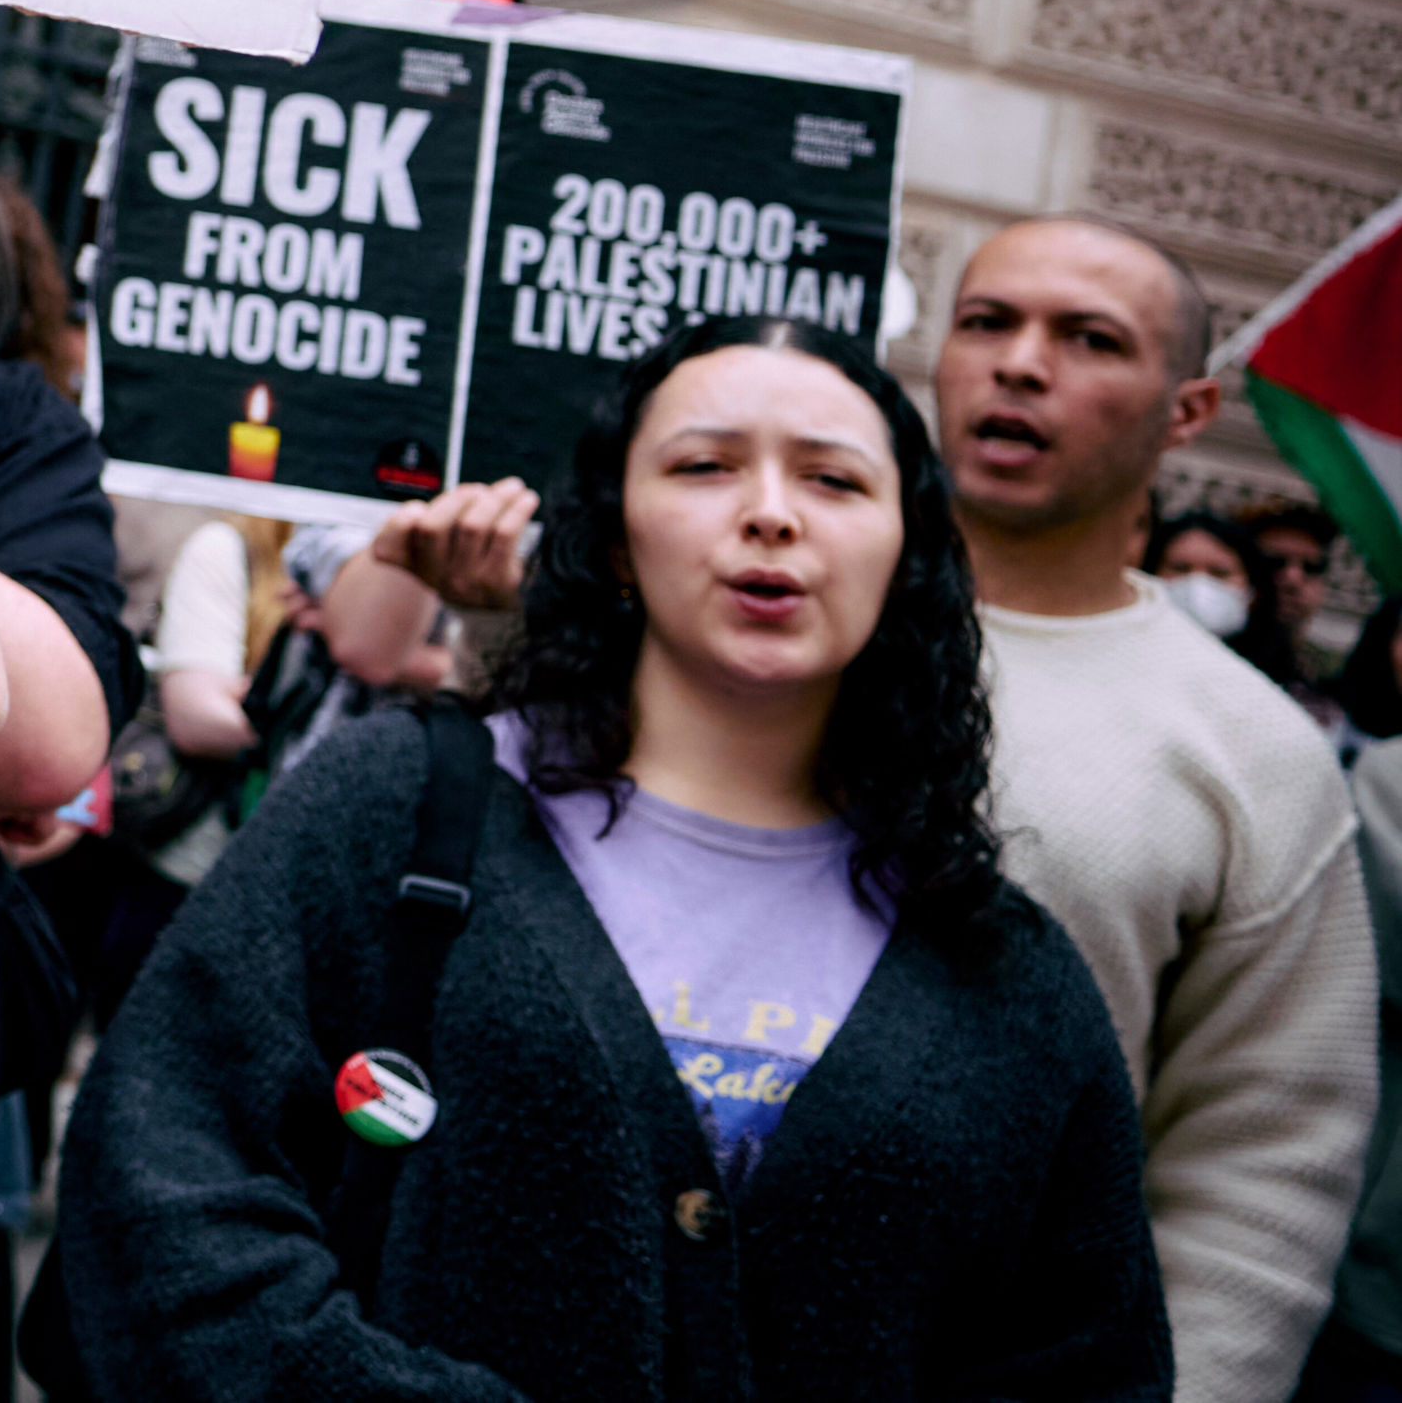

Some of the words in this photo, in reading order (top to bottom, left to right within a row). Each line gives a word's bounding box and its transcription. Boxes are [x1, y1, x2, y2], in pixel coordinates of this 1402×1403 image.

[146, 76, 433, 231] SICK
[183, 210, 365, 302] FROM
[549, 173, 828, 264] 200,000+
[500, 223, 865, 337] PALESTINIAN
[512, 285, 669, 362] LIVES
[109, 276, 427, 388] GENOCIDE
